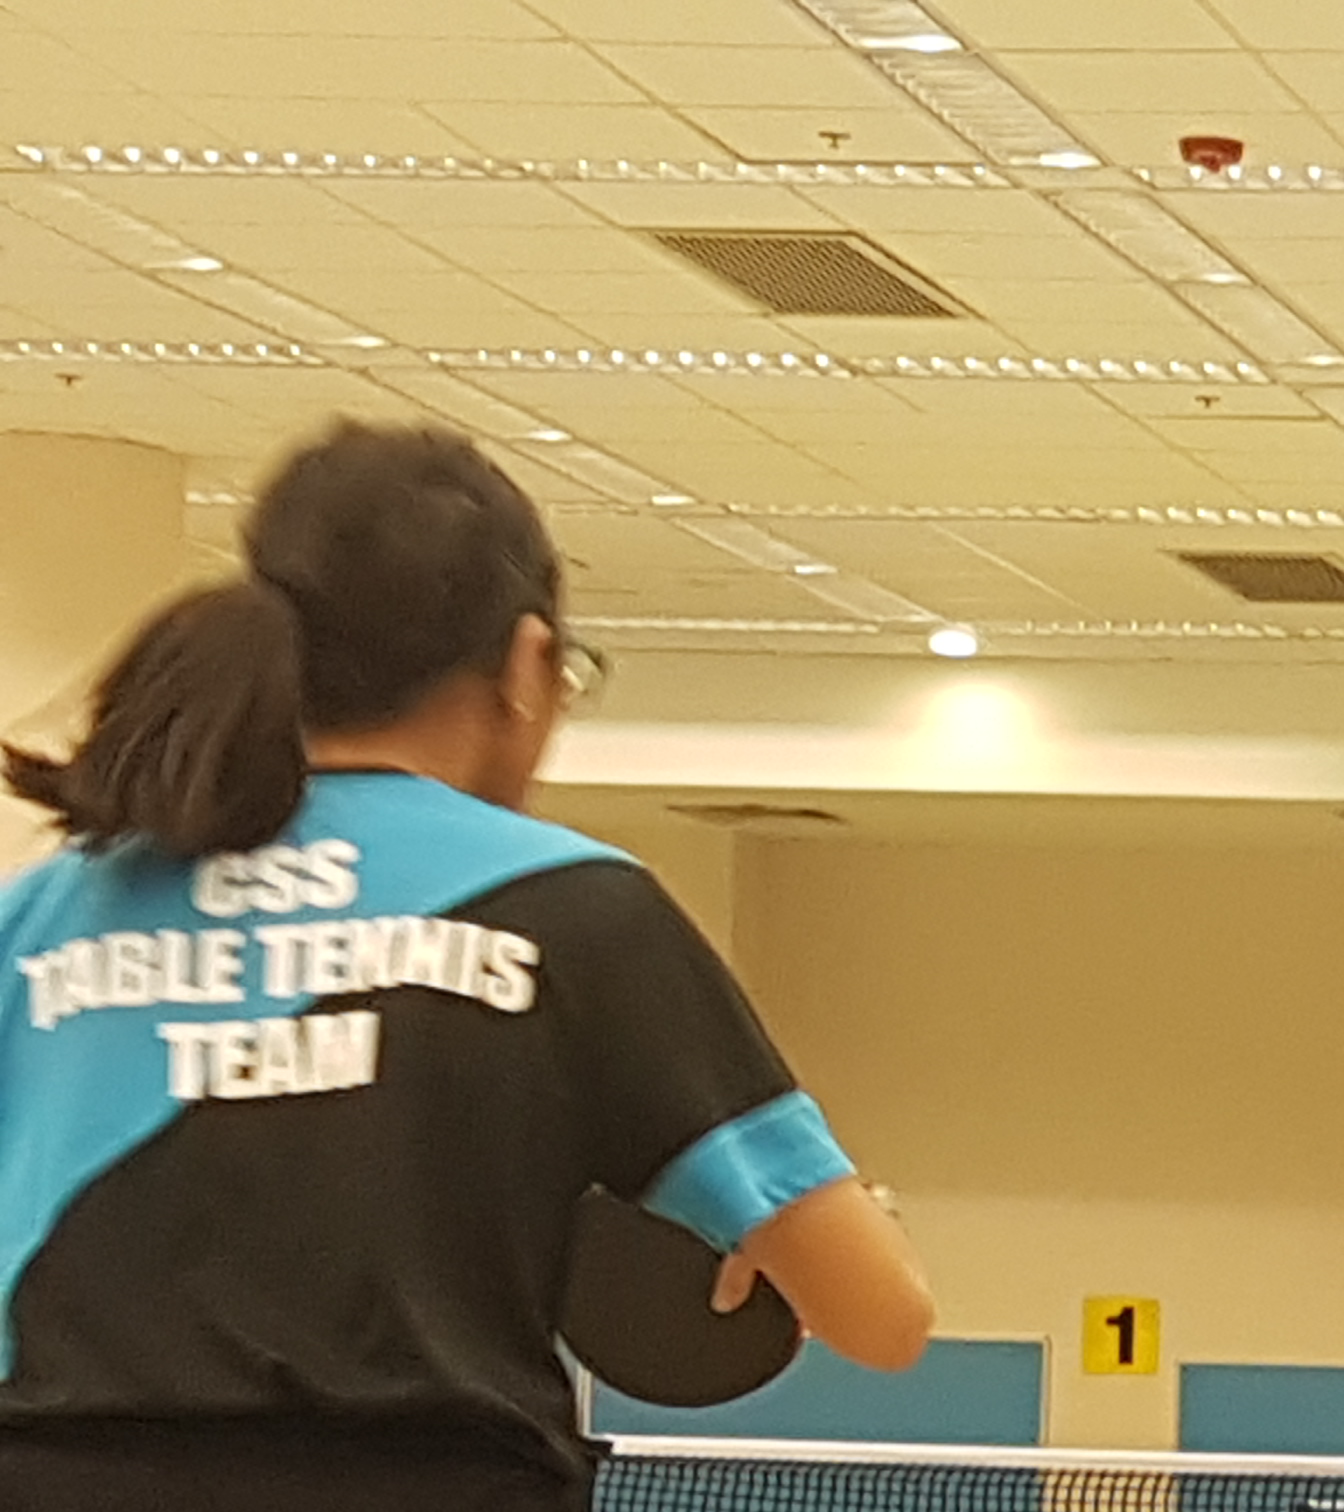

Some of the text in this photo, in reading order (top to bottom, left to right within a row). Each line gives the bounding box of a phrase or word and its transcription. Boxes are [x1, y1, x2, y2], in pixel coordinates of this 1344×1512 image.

[18, 915, 541, 1029] TABLE TENNIS
[158, 1011, 381, 1101] TEAM
[1106, 1307, 1134, 1364] 1
